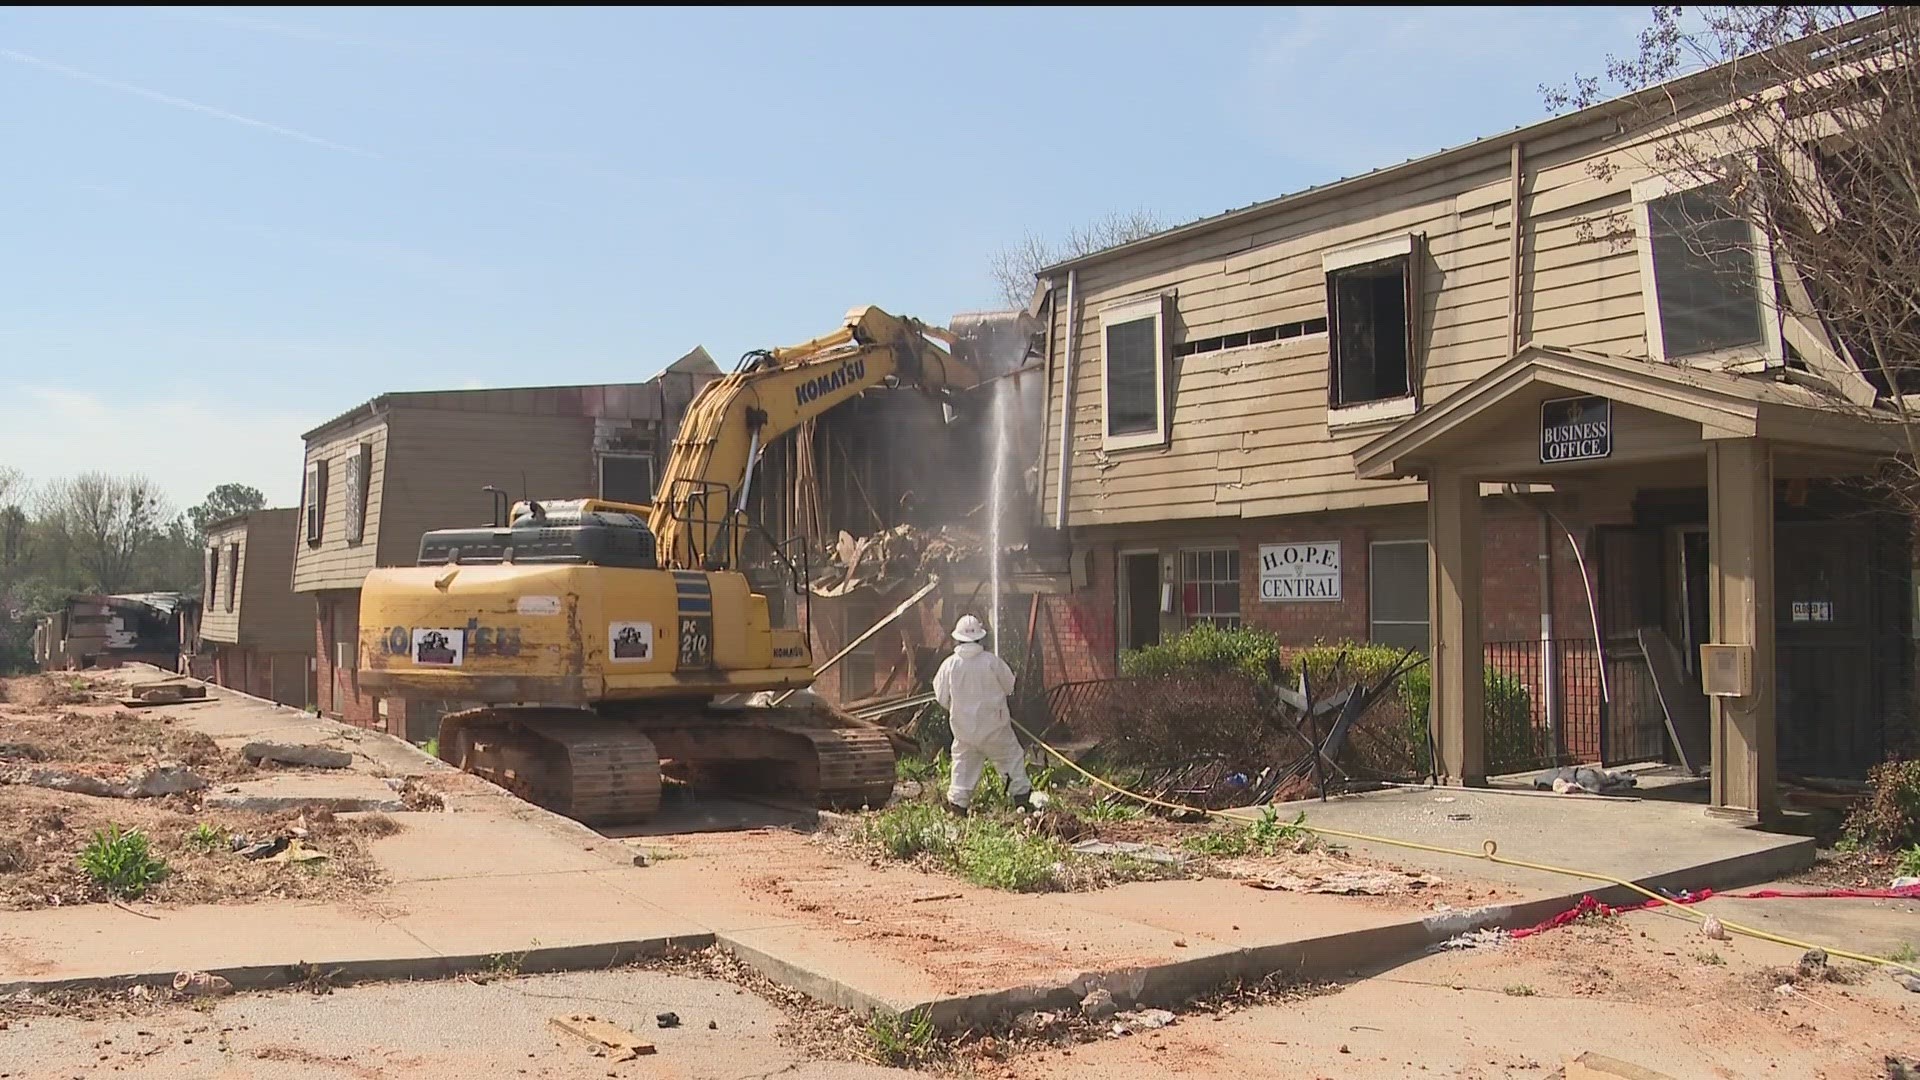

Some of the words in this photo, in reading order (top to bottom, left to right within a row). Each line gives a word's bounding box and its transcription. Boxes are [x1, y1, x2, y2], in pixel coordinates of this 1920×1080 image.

[795, 360, 865, 406] KOMATSU
[1545, 421, 1607, 444] BUSINESS
[1549, 438, 1601, 459] OFFICE
[1263, 546, 1338, 571] H.O.P.E.
[1262, 578, 1338, 598] CENTRAL
[682, 620, 697, 634] PC
[681, 634, 707, 652] 210
